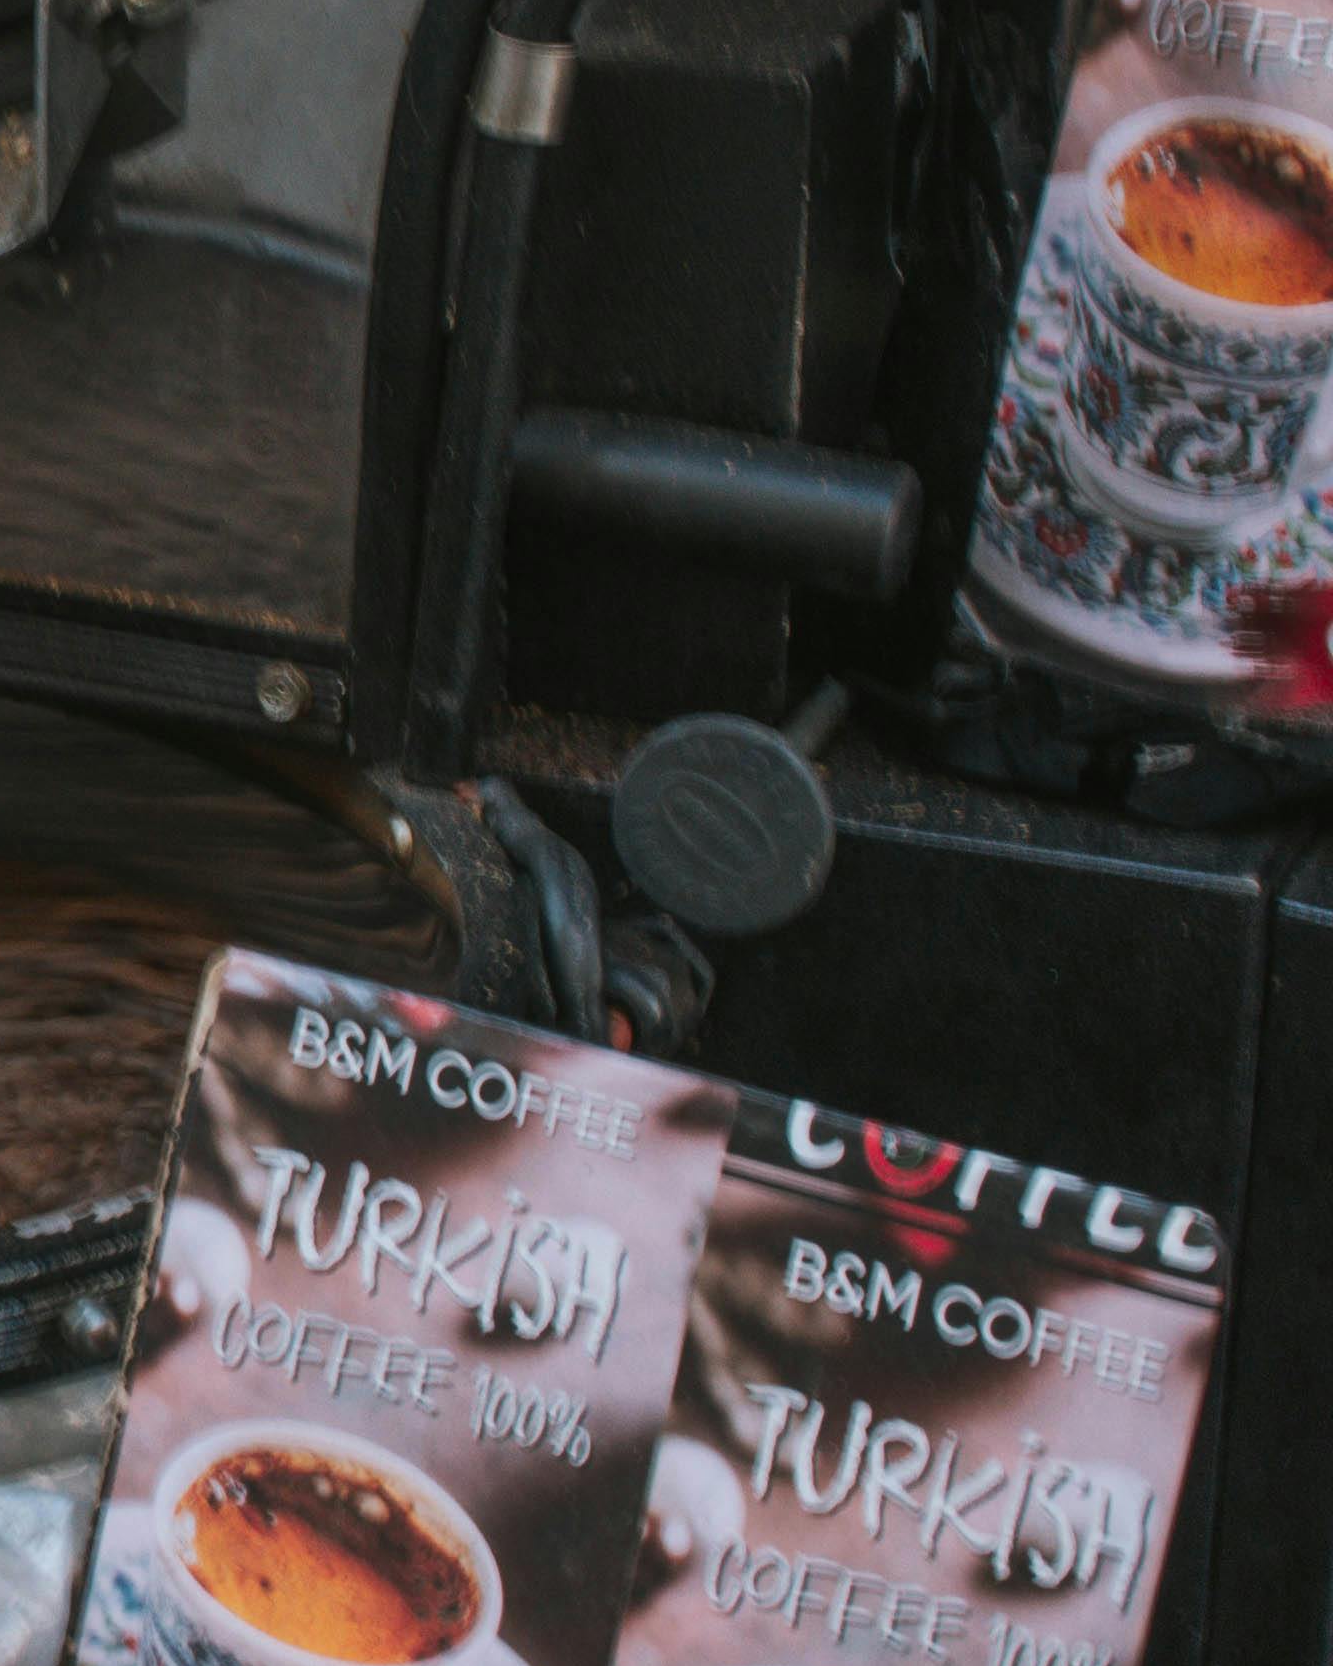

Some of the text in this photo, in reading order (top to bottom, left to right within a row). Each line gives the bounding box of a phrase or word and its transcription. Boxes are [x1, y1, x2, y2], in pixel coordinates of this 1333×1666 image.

[288, 1006, 644, 1162] B&M COFFEE
[212, 1291, 591, 1468] COFFEE 100%
[784, 1237, 1170, 1403] B&M COFFEE
